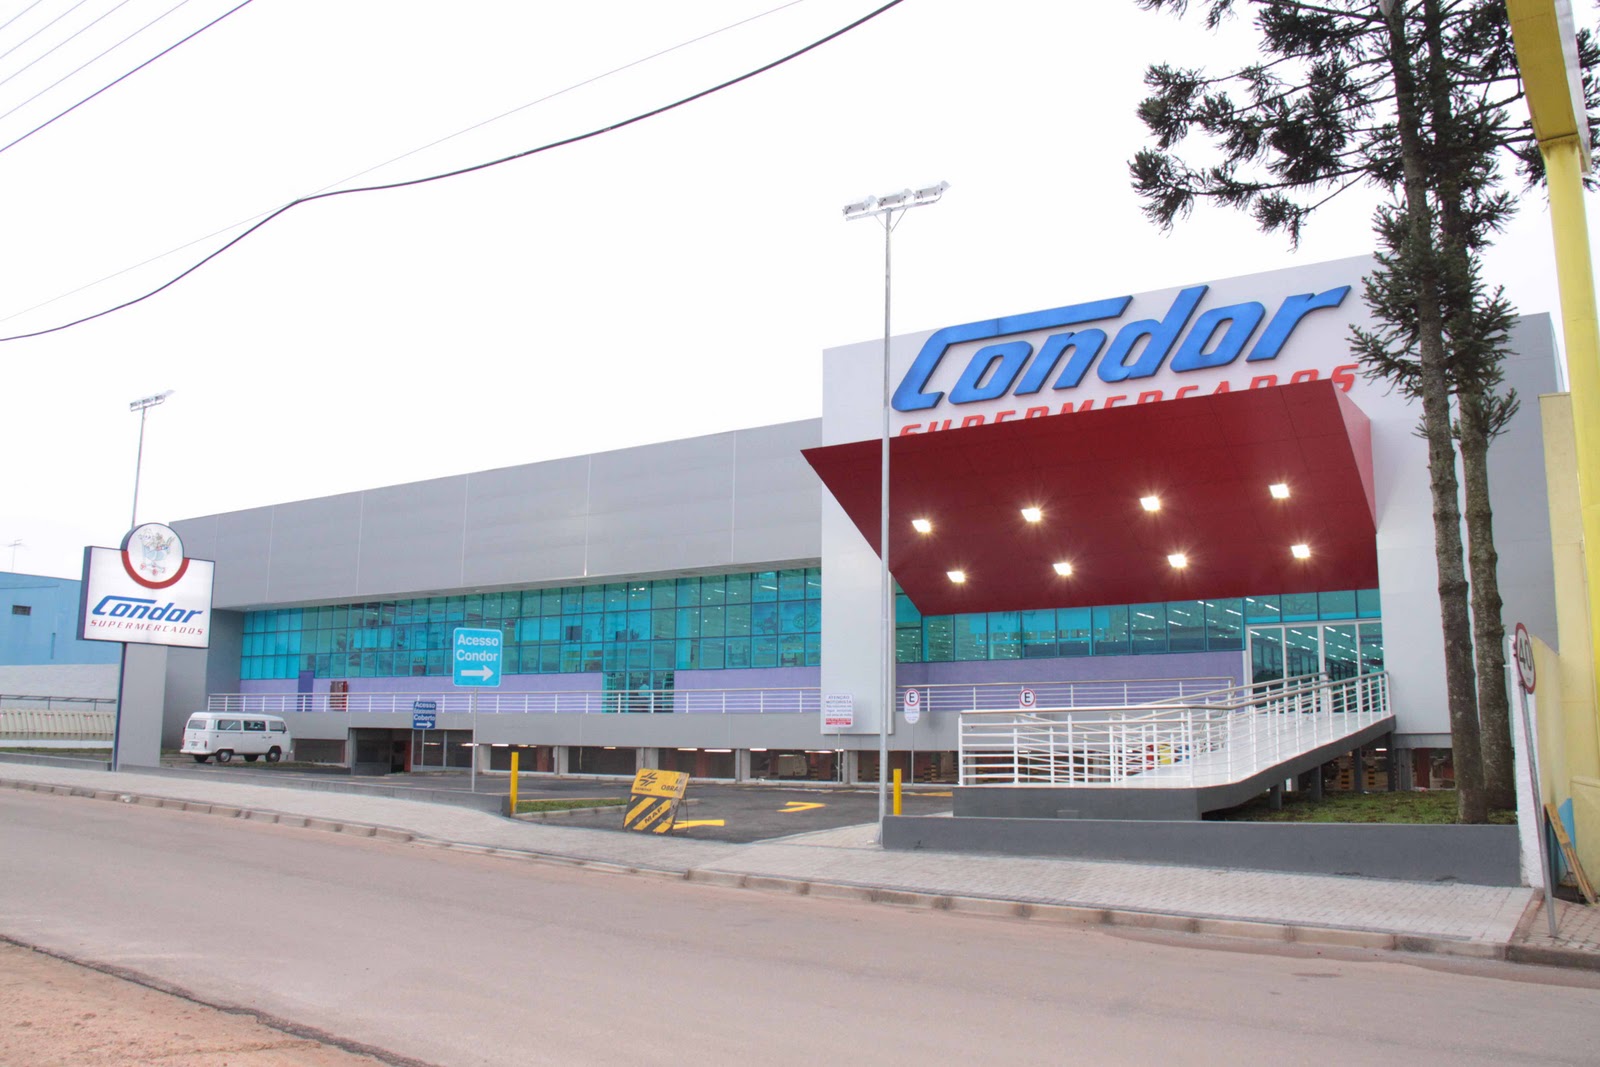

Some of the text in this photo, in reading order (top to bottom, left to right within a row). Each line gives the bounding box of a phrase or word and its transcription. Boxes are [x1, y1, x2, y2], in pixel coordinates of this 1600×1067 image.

[891, 285, 1352, 412] Condor
[92, 595, 204, 623] Condor
[90, 620, 203, 635] SUPERMERCADOS
[457, 634, 499, 646] Acesso
[456, 649, 498, 661] Condor
[1519, 638, 1532, 671] 40
[908, 692, 915, 703] E
[1024, 692, 1031, 703] E
[644, 807, 663, 824] MAP
